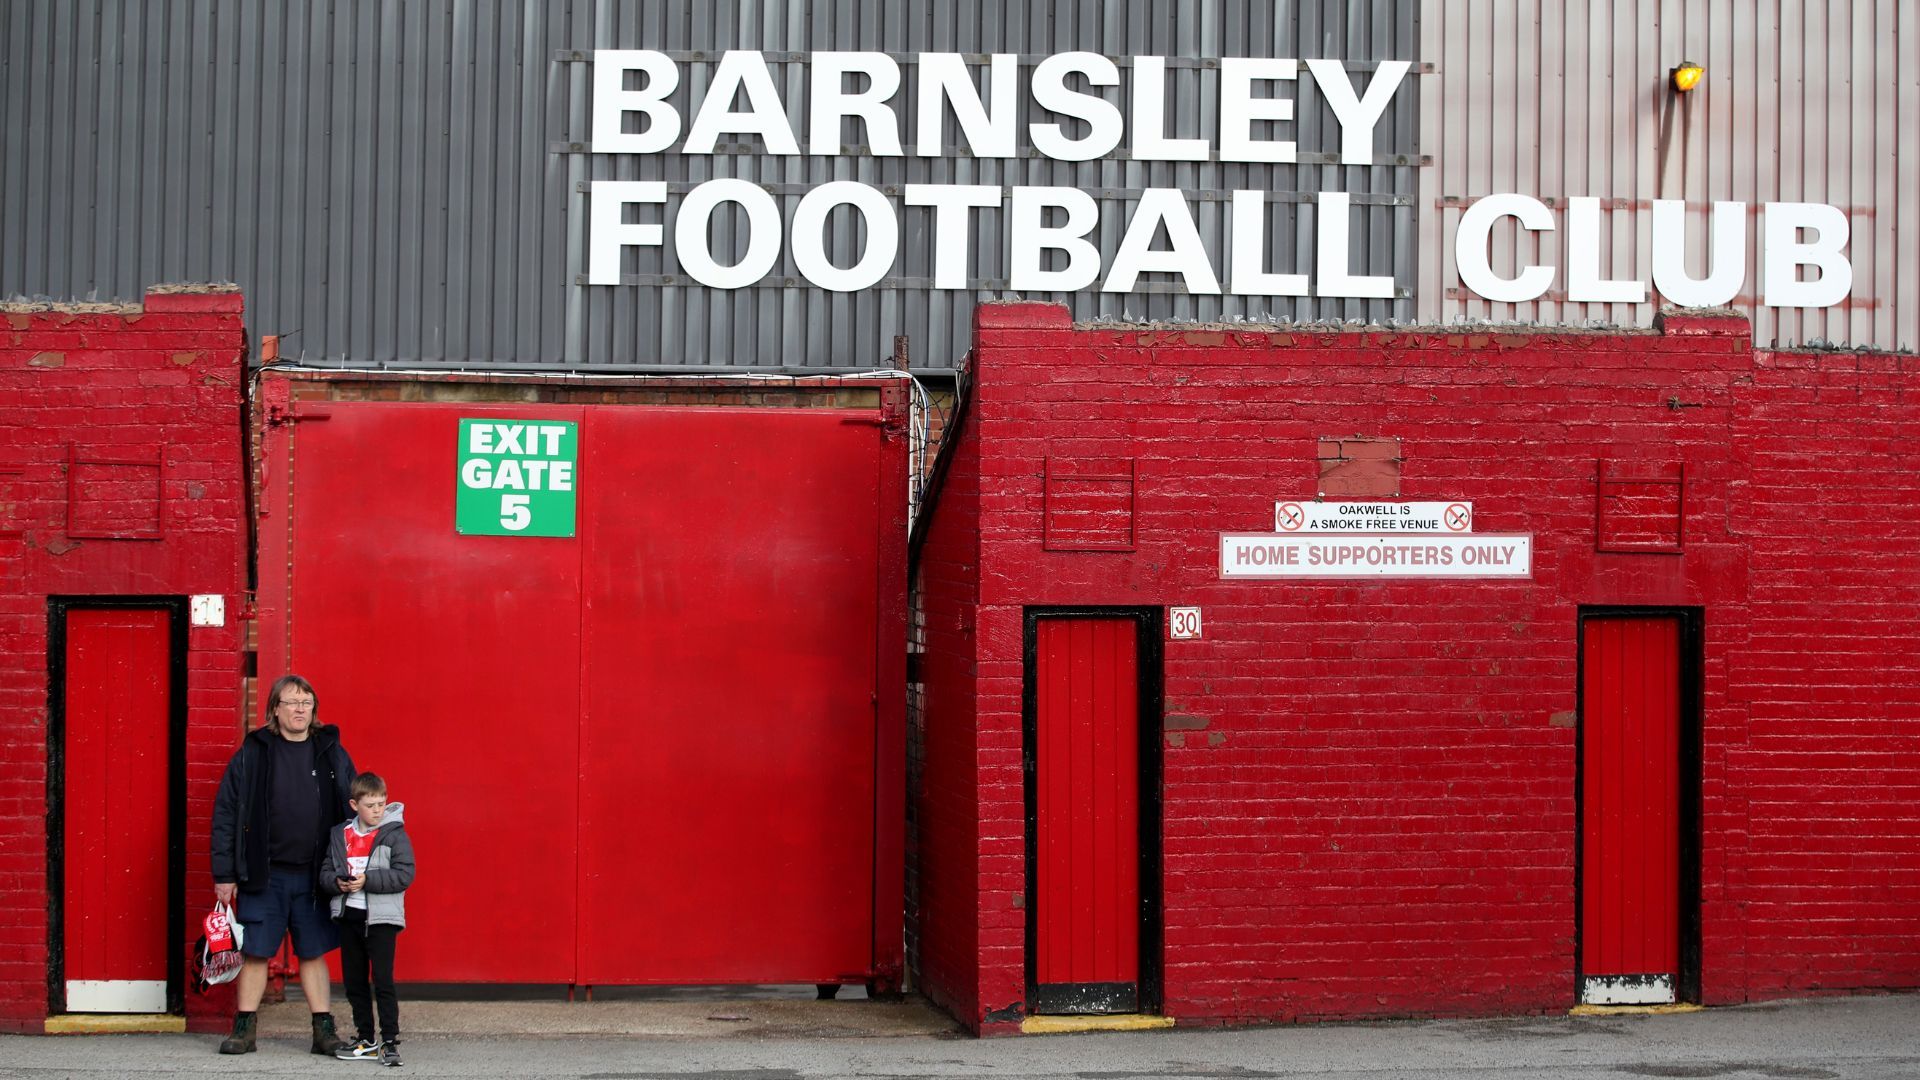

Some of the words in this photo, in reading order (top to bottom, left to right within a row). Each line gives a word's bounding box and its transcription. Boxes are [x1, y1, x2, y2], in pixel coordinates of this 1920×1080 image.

[592, 49, 1412, 165] BARNSLEY
[589, 178, 1395, 298] FOOTBALL
[1455, 192, 1853, 308] CLUB
[470, 423, 566, 456] EXIT
[461, 458, 572, 491] GATE
[500, 494, 531, 531] 5
[1310, 519, 1319, 529] A
[1321, 519, 1363, 529] SMOKE
[1366, 519, 1397, 529] FREE
[1400, 519, 1439, 529] VENUE
[1339, 505, 1397, 515] OAKWELL
[1400, 505, 1411, 515] IS
[1236, 545, 1300, 566] HOME
[1308, 545, 1454, 566] SUPPORTERS
[1461, 545, 1516, 566] ONLY
[1175, 612, 1197, 634] 30
